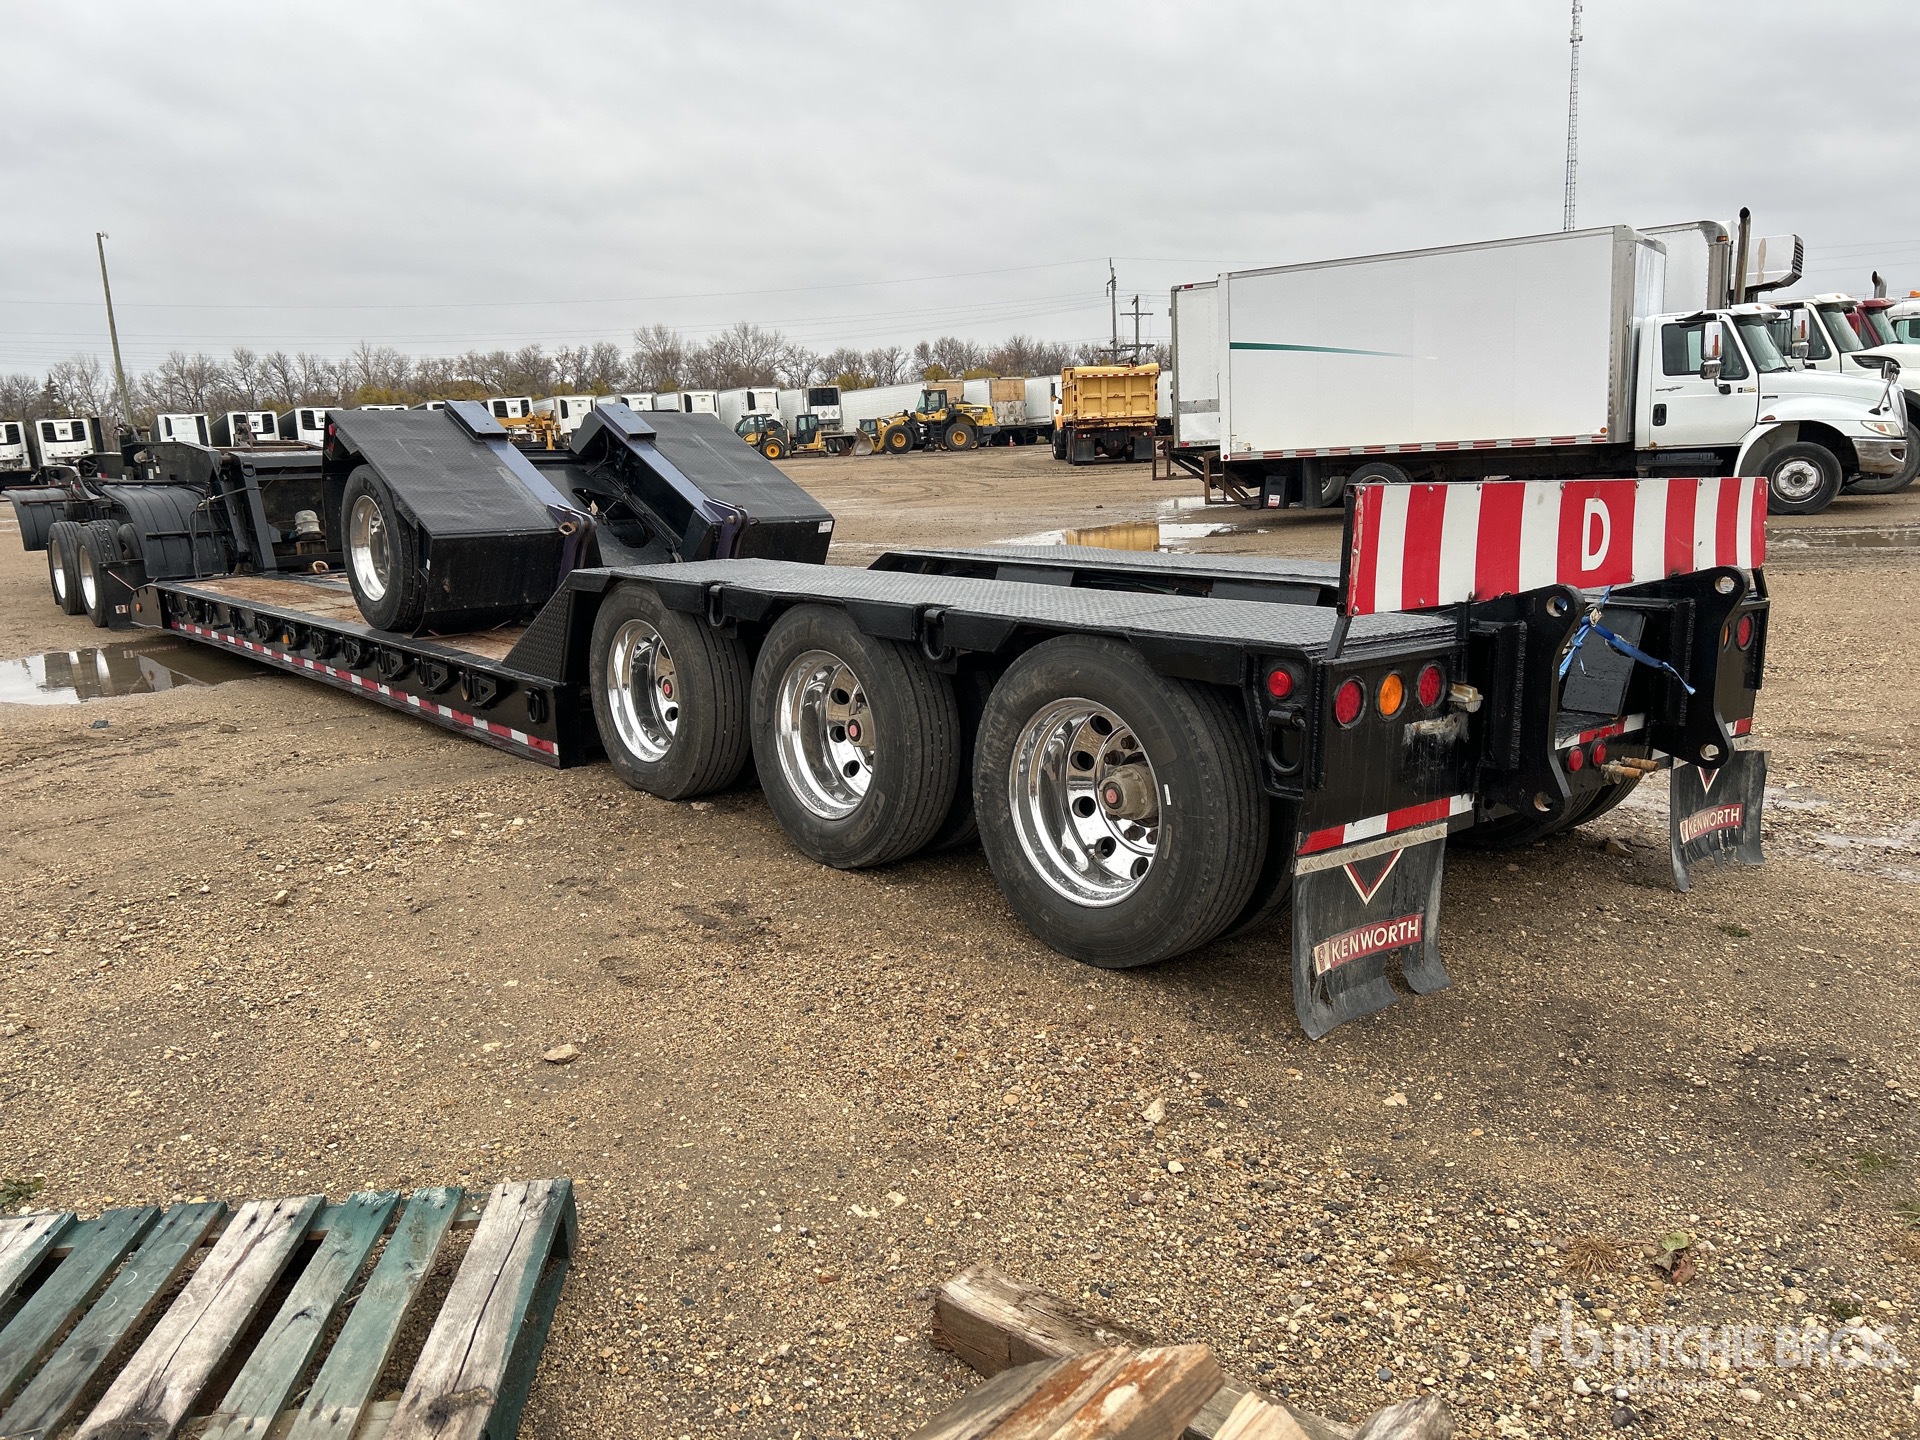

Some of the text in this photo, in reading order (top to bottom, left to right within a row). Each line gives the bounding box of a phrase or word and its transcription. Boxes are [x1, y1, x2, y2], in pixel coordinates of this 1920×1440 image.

[1581, 497, 1611, 572] D
[1688, 807, 1740, 836] KENWORTH
[1330, 917, 1419, 961] KENWORTH
